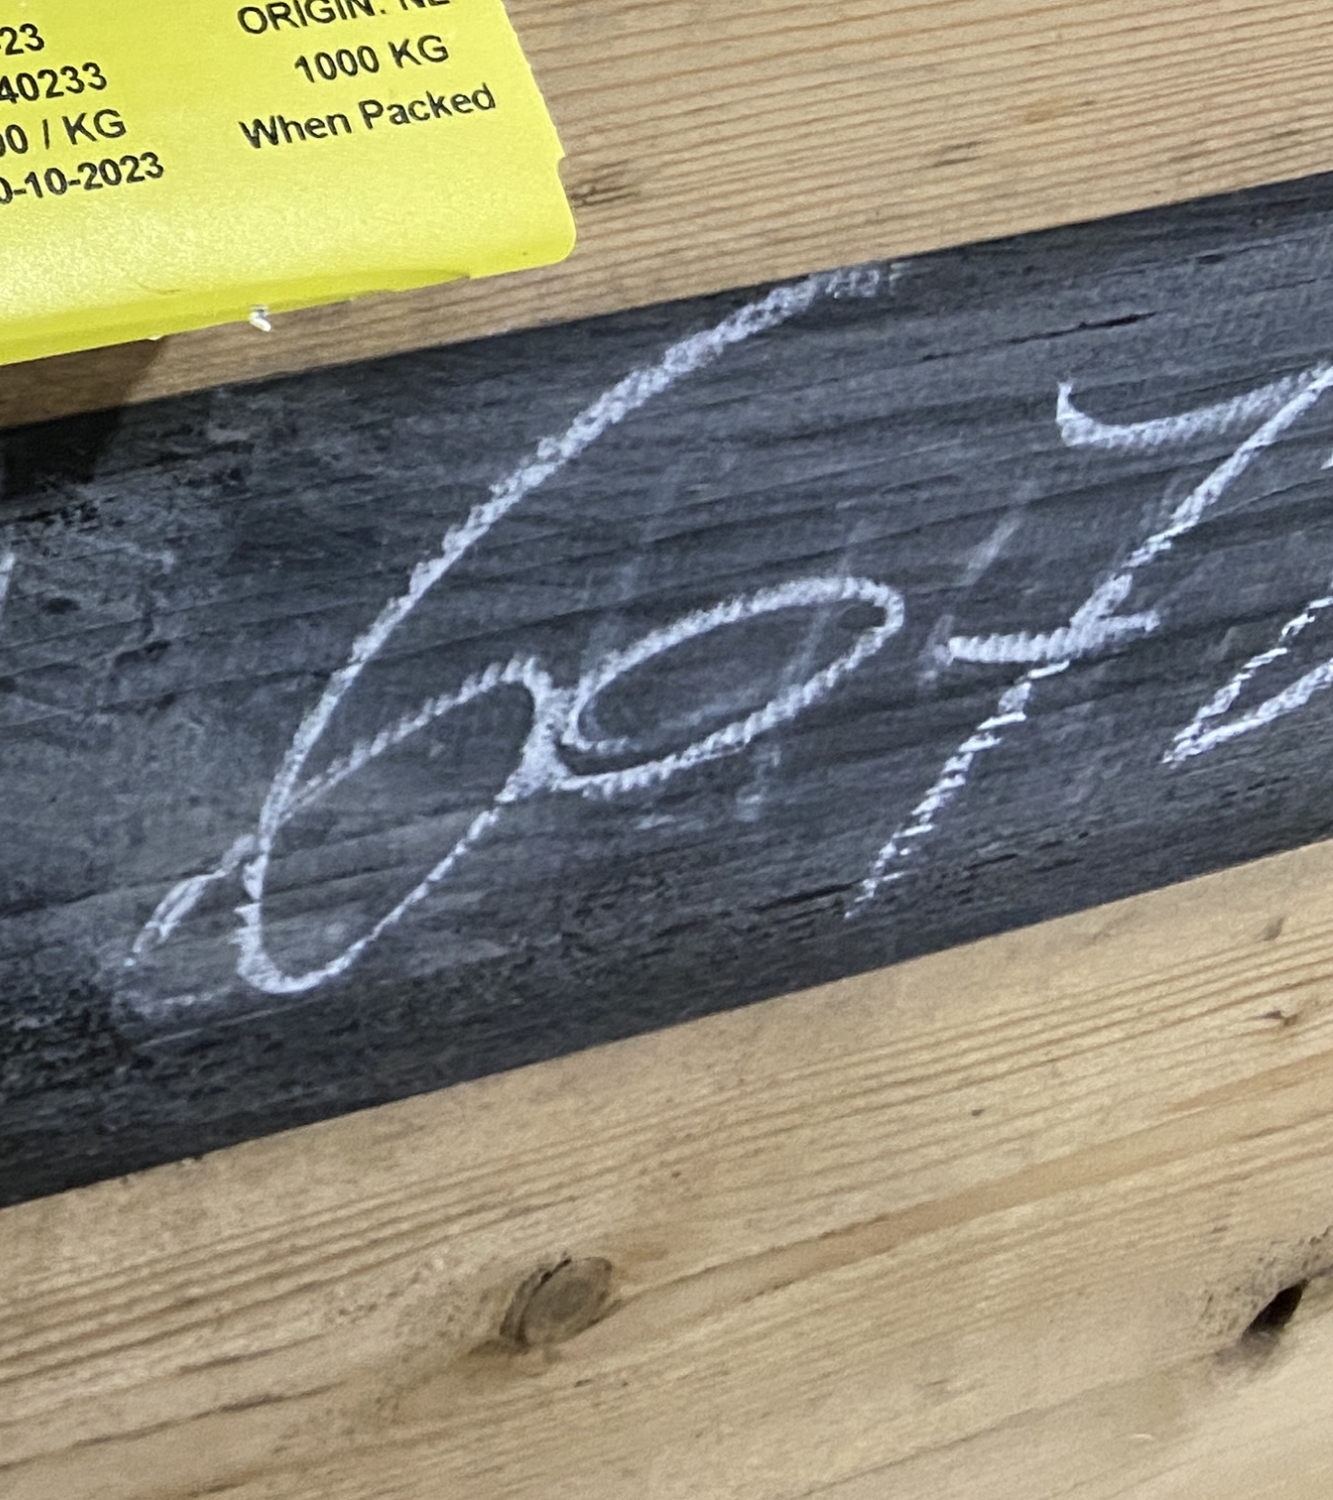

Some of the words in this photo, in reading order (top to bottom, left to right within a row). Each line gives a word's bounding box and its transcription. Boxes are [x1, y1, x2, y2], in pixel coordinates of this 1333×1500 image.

[294, 45, 380, 84] 1000
[387, 34, 450, 69] KG
[61, 108, 127, 146] KG
[237, 113, 353, 149] When
[357, 82, 497, 130] Packed
